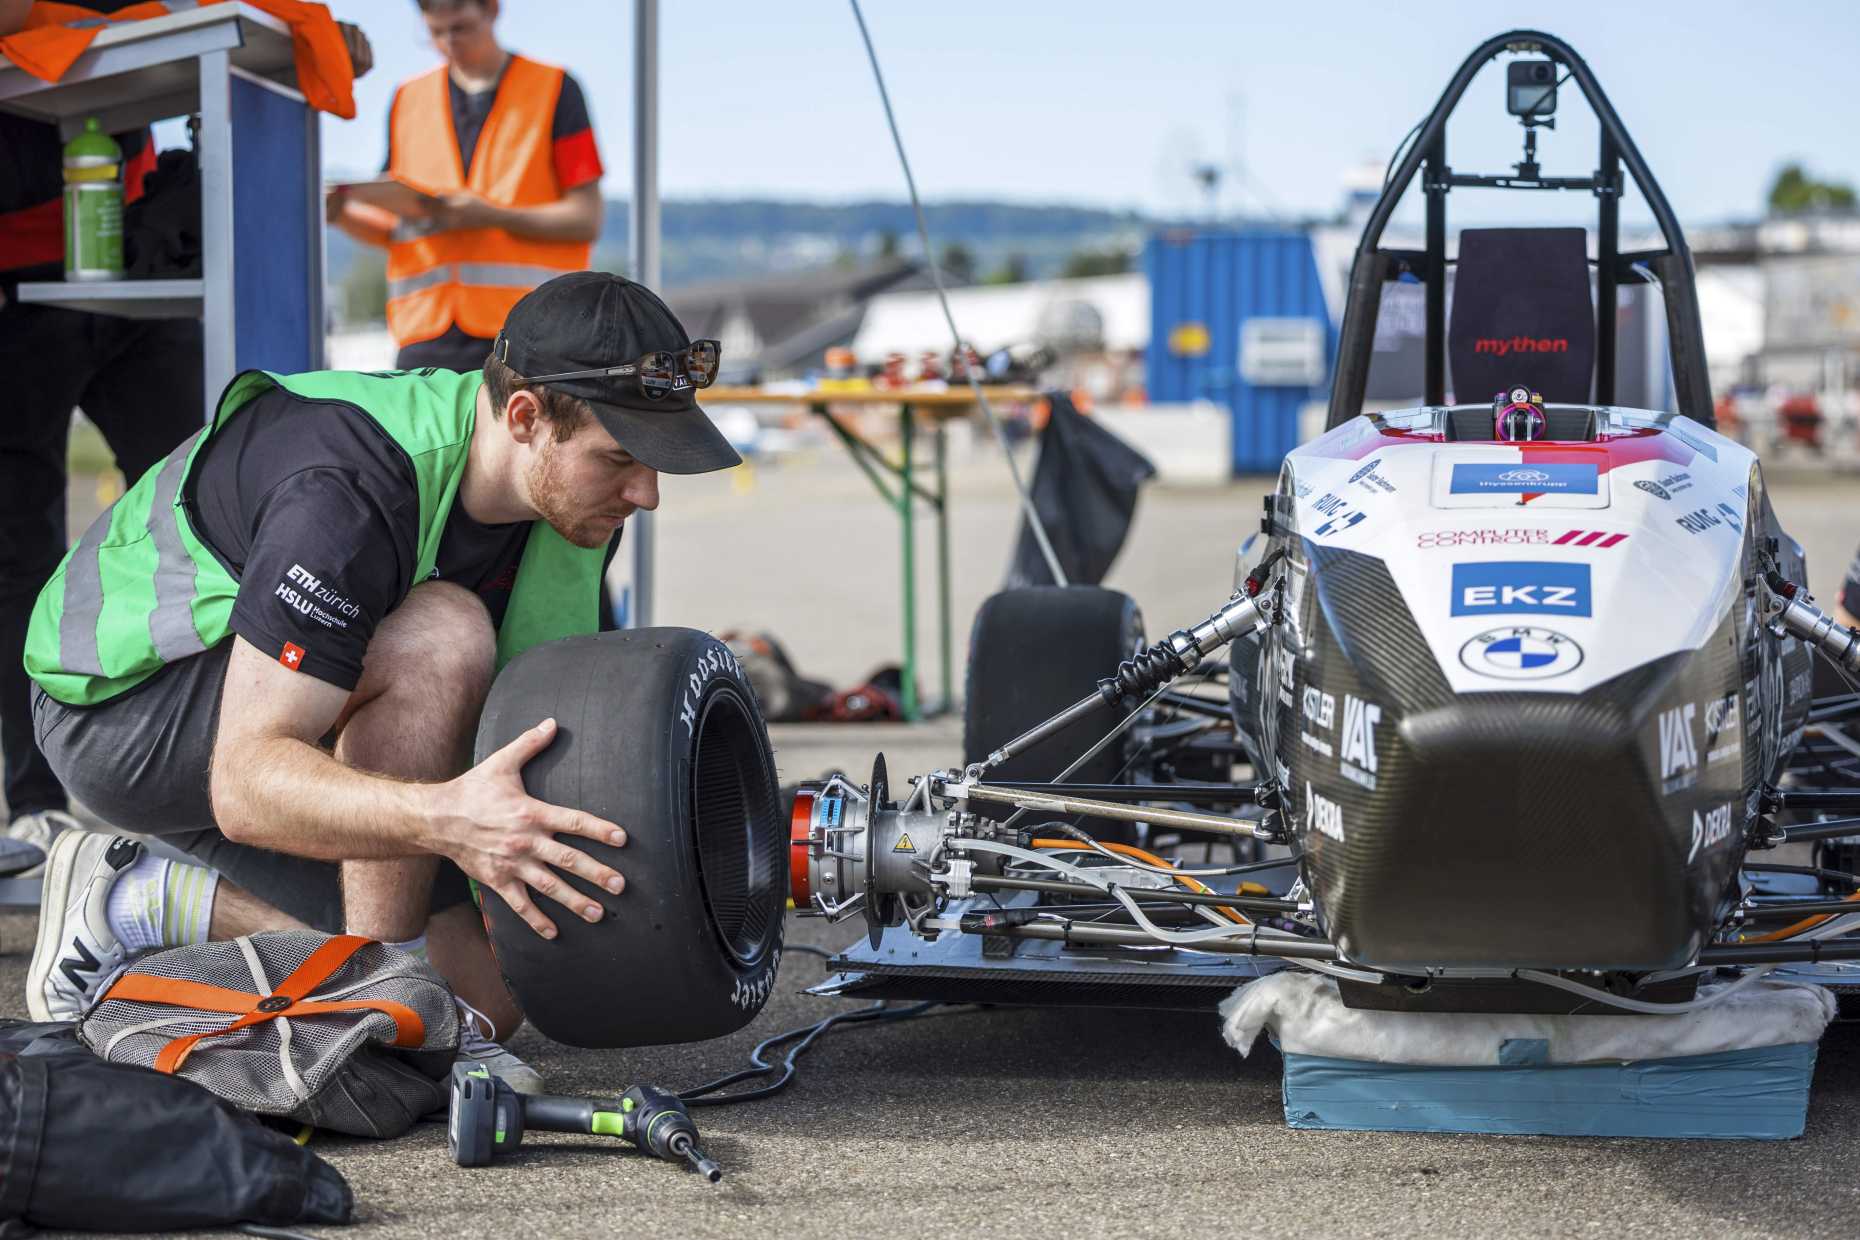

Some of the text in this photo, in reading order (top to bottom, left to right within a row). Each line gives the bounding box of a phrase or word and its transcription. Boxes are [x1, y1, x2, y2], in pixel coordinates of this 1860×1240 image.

[1416, 537, 1549, 549] CONTROLS
[1417, 529, 1548, 542] COMPUTER
[274, 582, 314, 615] HSLU
[1463, 585, 1577, 607] EKZ
[680, 645, 740, 740] Hoosier
